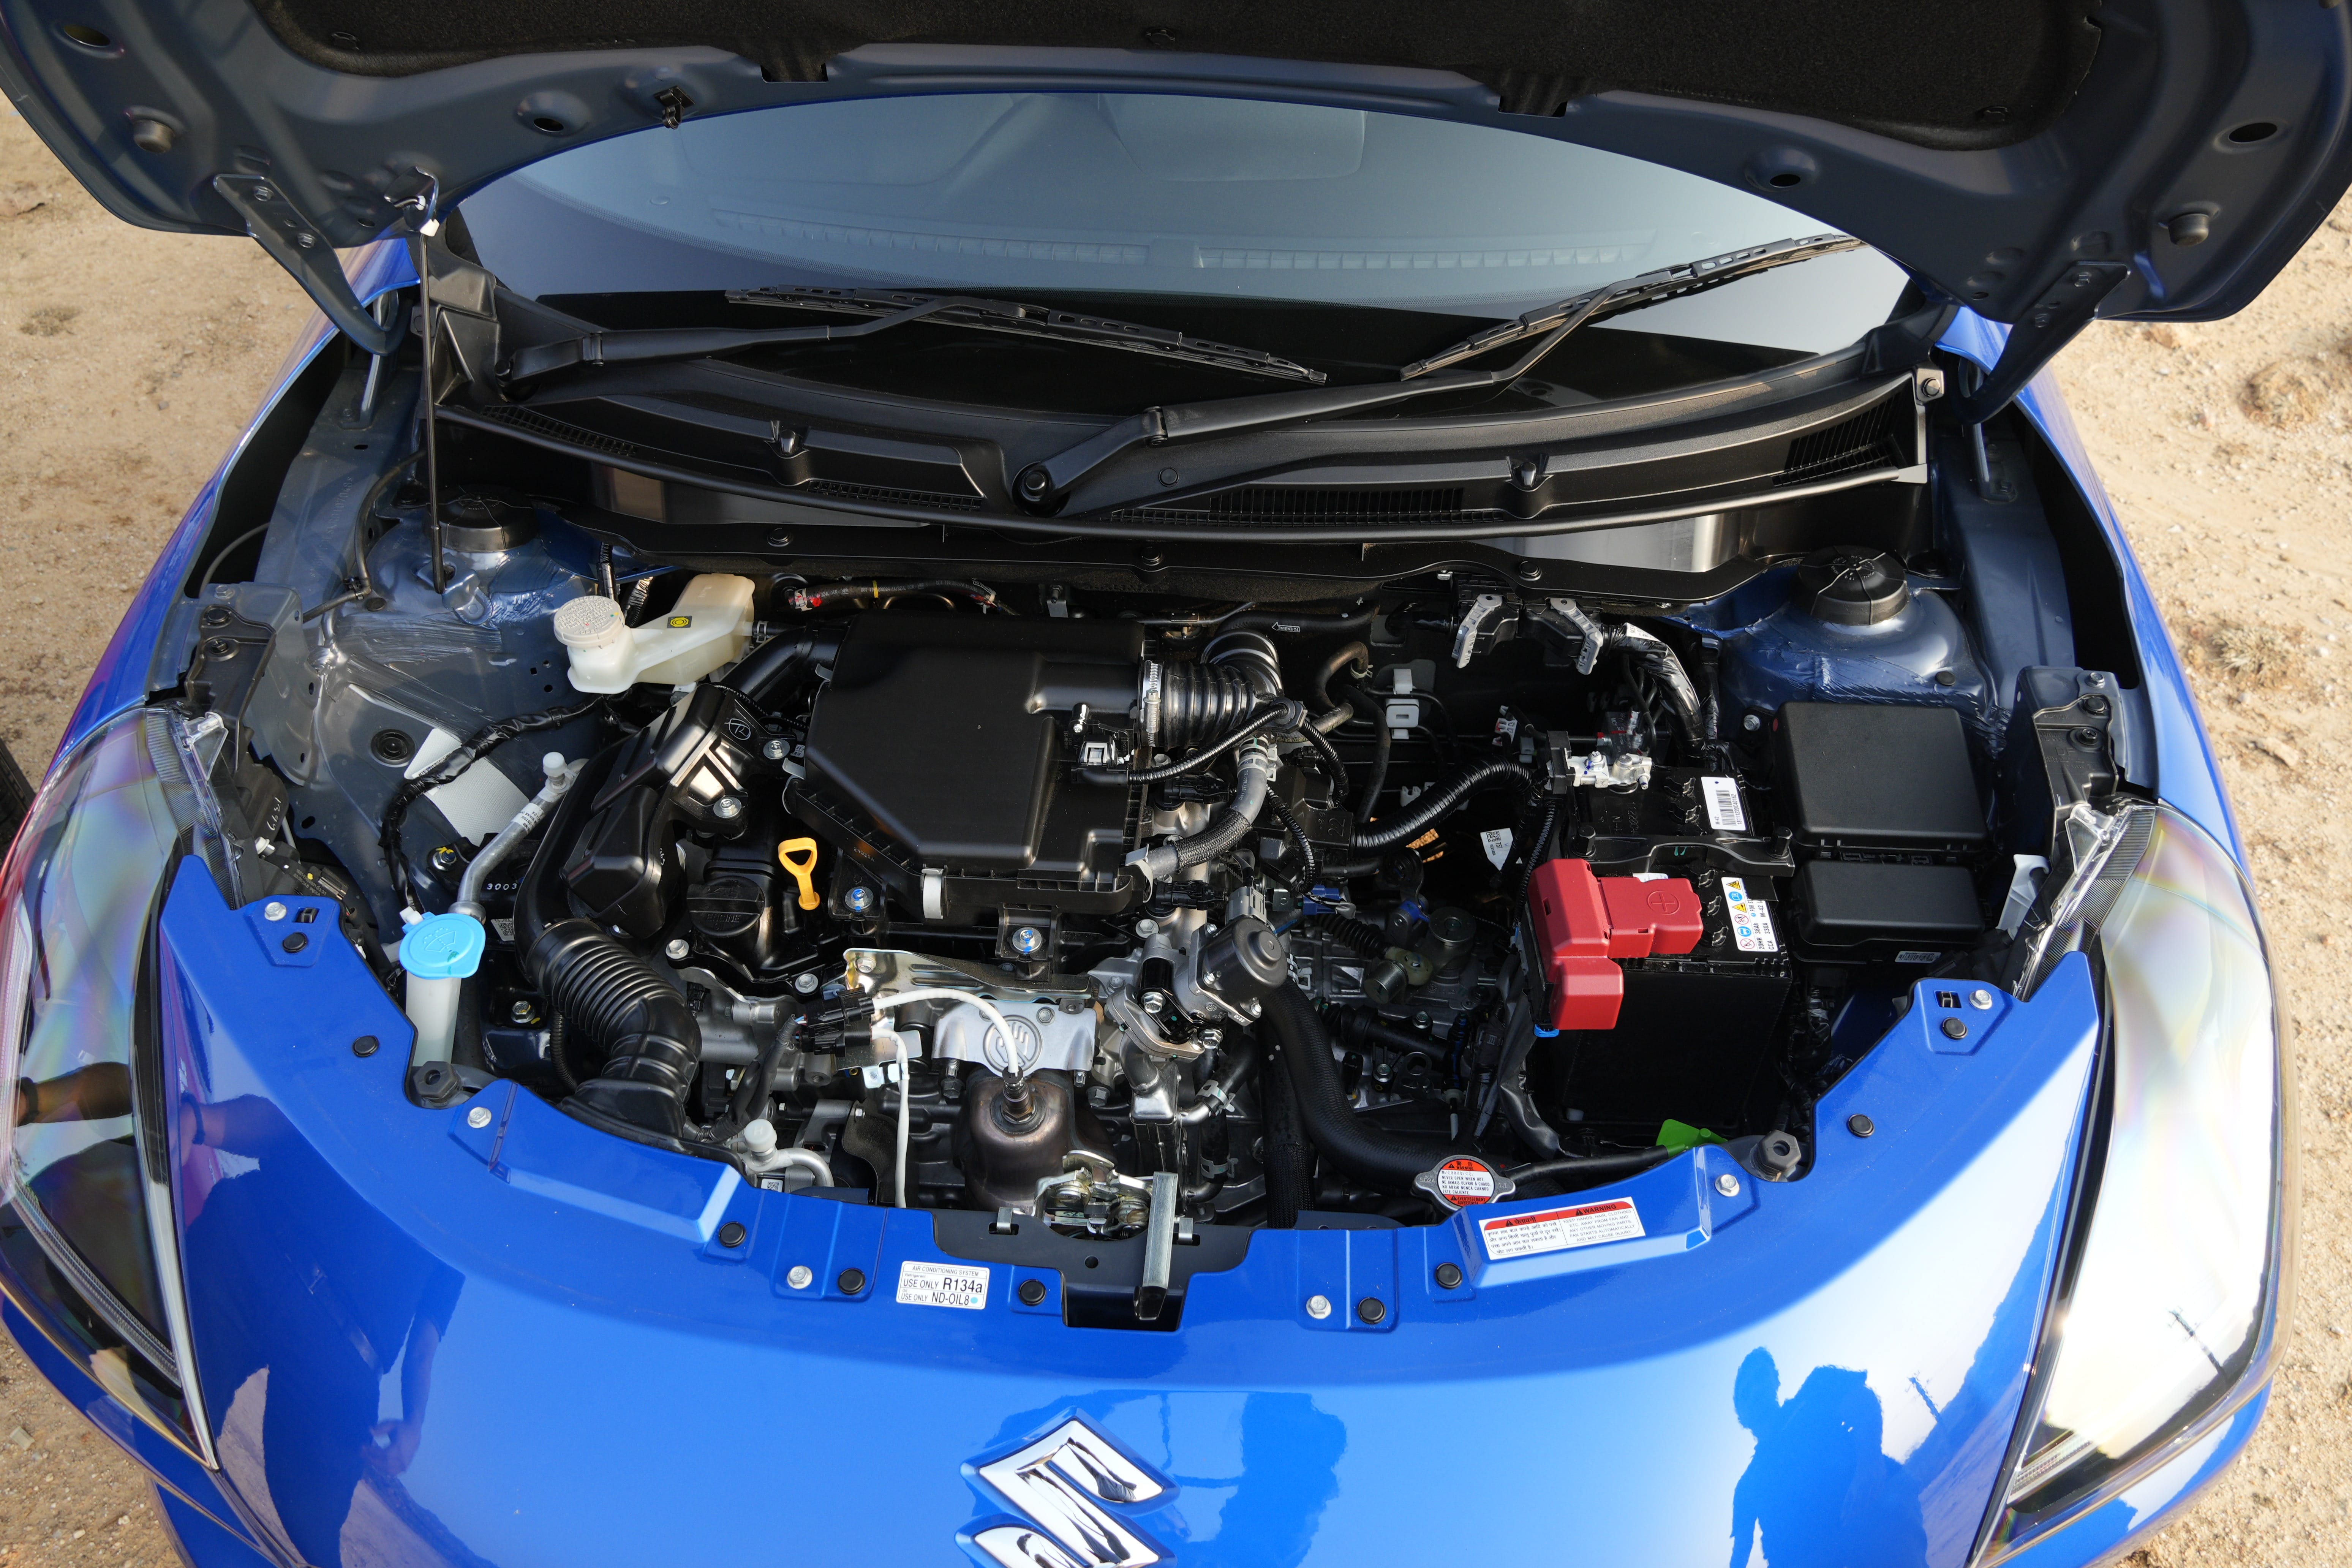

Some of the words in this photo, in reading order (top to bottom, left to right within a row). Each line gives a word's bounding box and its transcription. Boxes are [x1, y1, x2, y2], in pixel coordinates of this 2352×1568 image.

[1756, 937, 1765, 949] 20HR
[1583, 1204, 1617, 1214] WARNING
[1514, 1216, 1536, 1224] चेतावनी
[1599, 1224, 1634, 1233] AUTOMATICALLY
[922, 1266, 958, 1274] CONDITIONING
[904, 1278, 918, 1287] USE
[920, 1280, 939, 1289] ONLY
[943, 1277, 982, 1293] R134a
[932, 1291, 969, 1305] ND-OIL8
